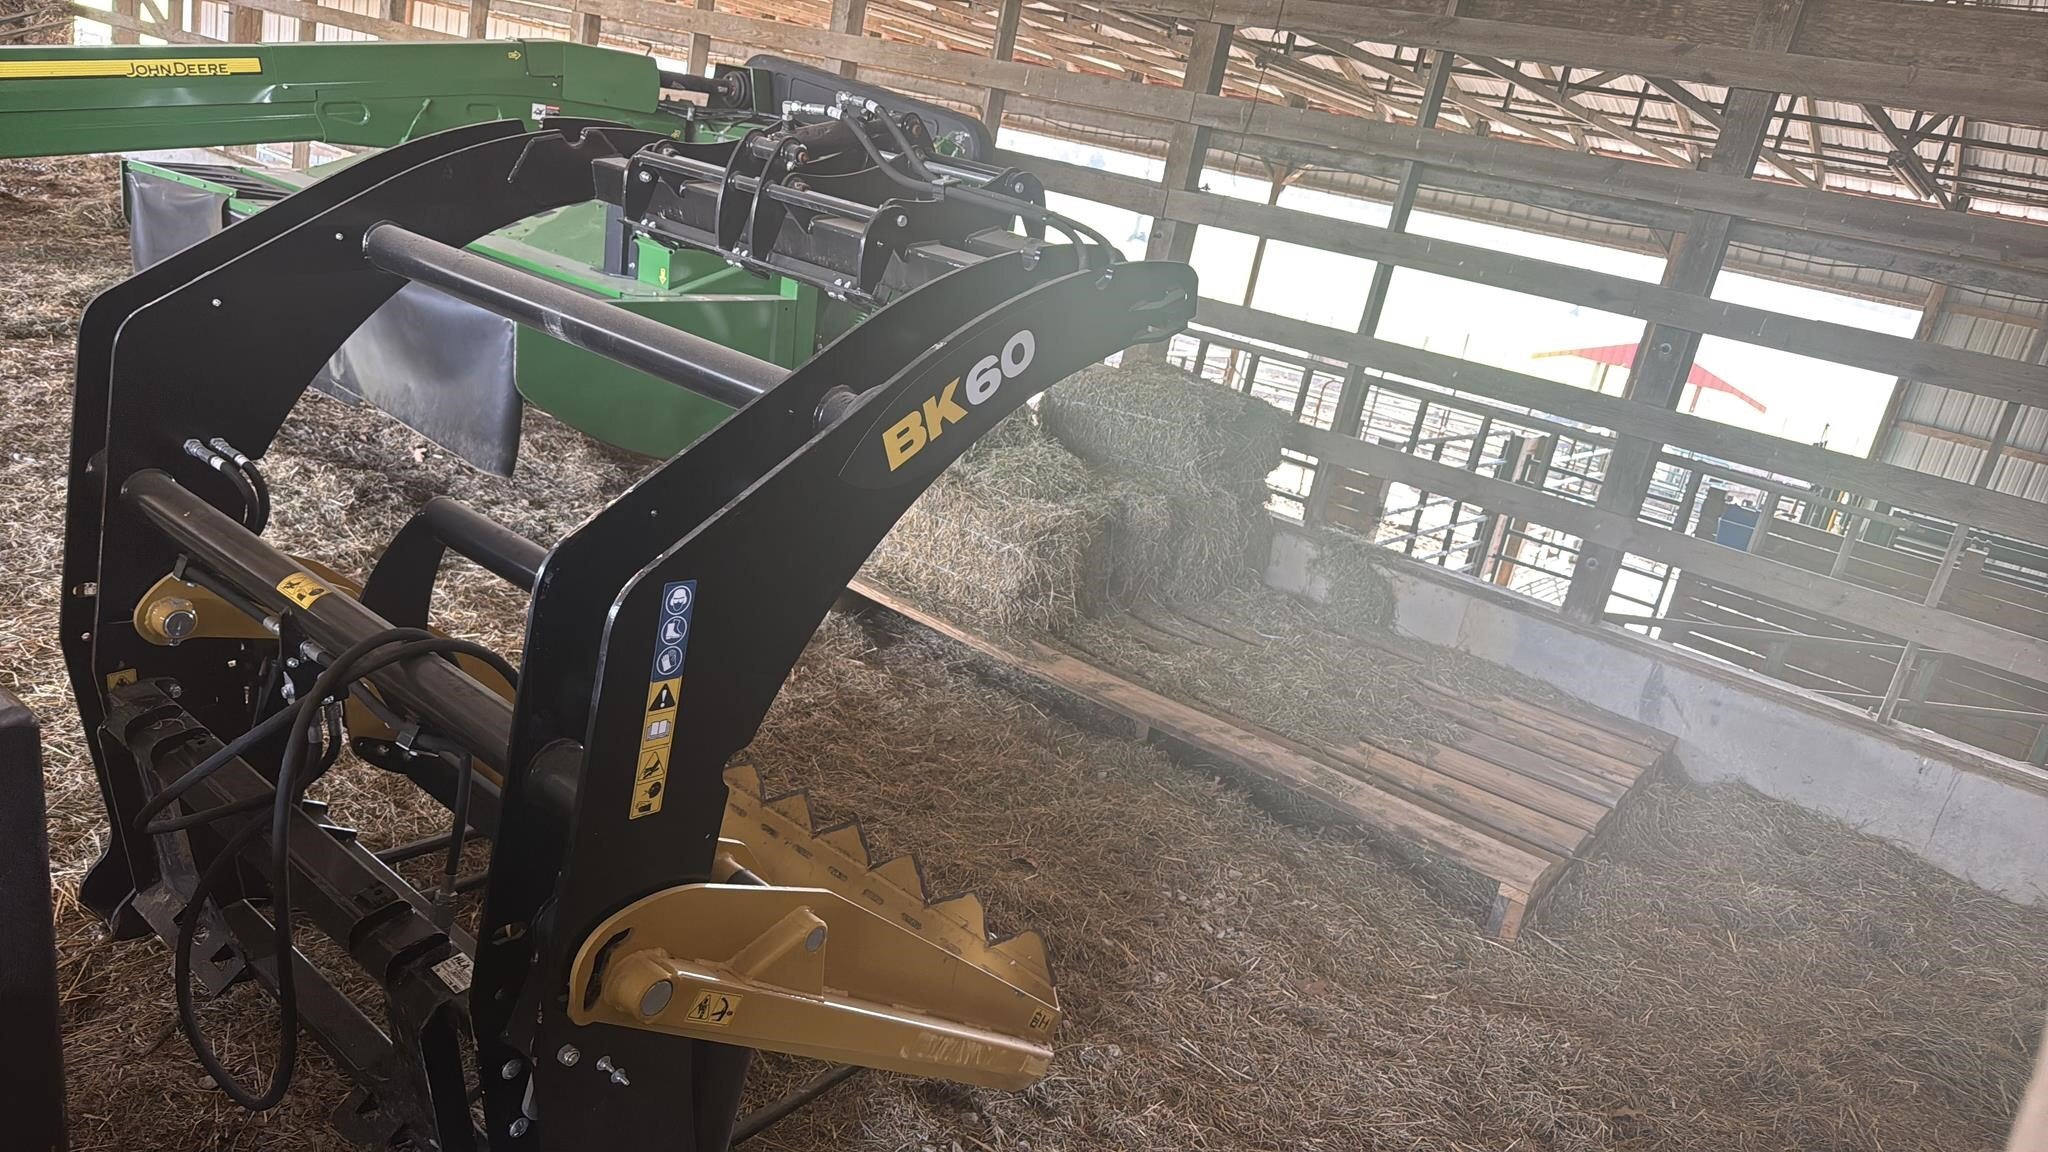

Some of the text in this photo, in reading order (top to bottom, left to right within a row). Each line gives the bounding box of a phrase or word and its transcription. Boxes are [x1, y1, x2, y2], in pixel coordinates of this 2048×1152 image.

[127, 62, 229, 76] JOHN DEERE
[882, 329, 1036, 472] BK60
